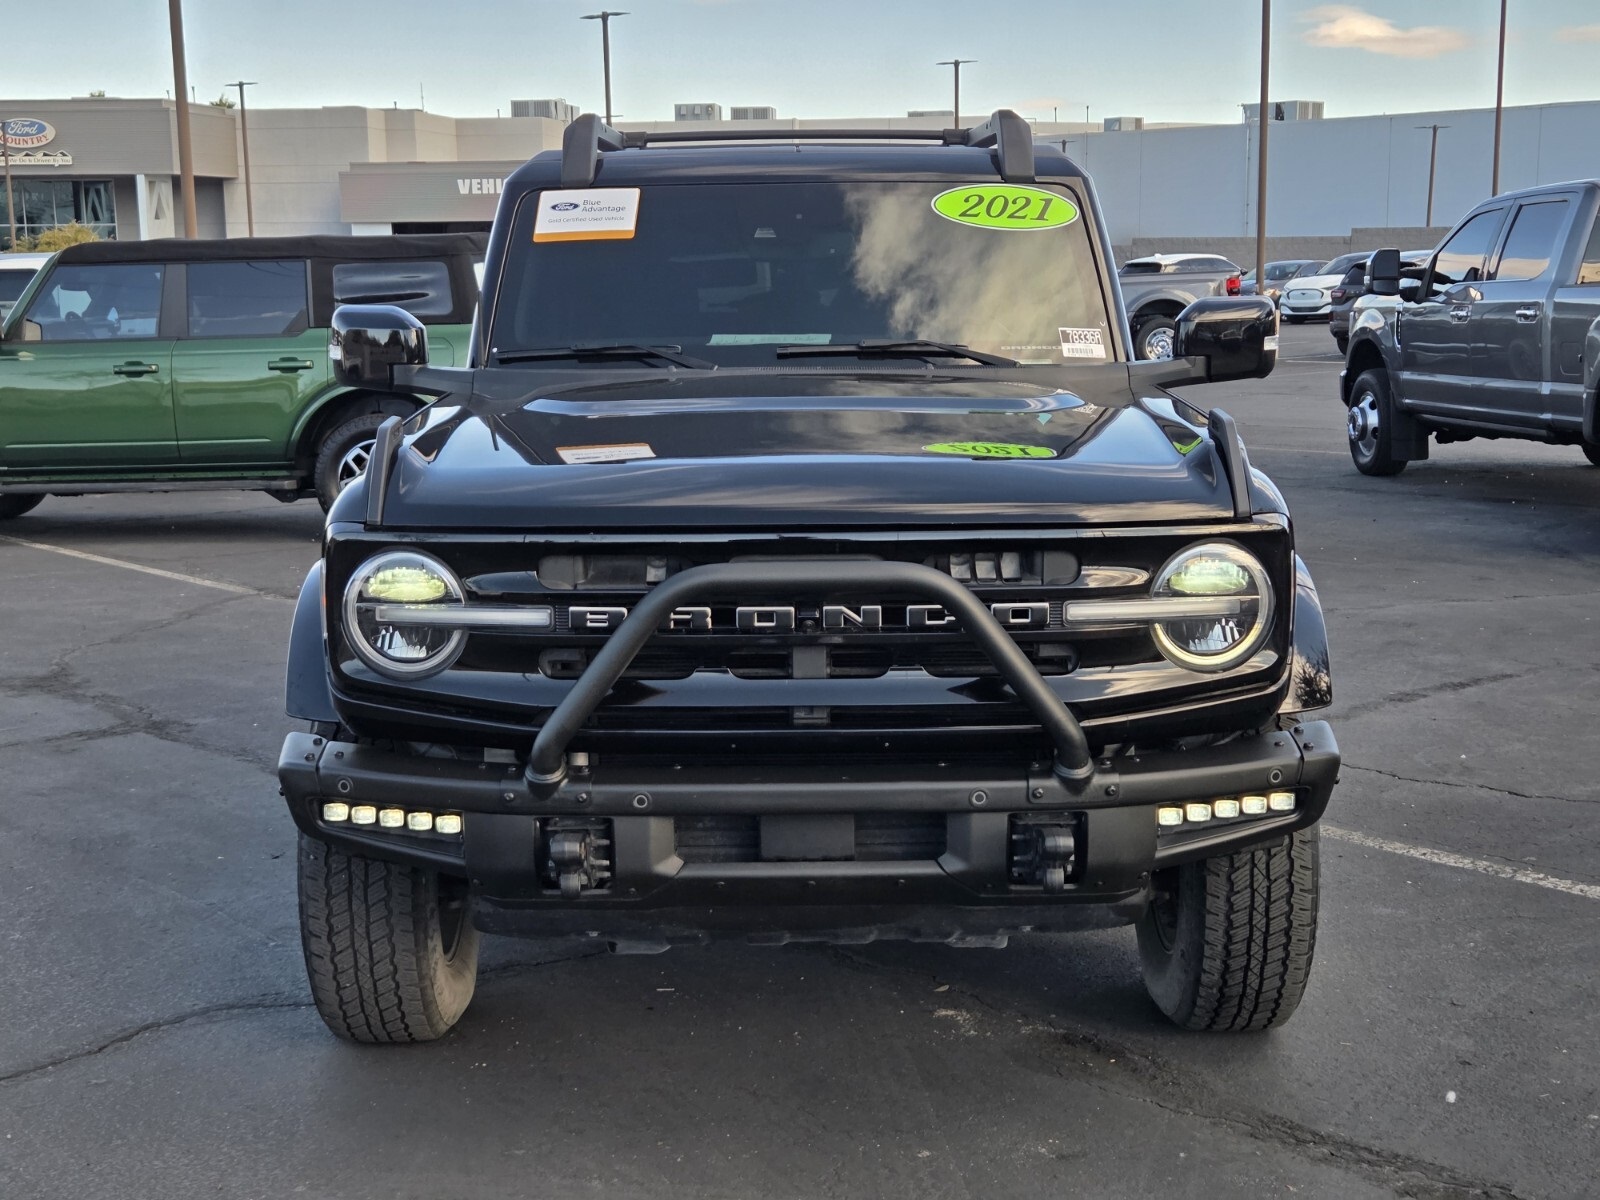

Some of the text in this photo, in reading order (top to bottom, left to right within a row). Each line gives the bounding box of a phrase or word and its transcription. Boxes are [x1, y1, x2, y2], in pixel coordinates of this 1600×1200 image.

[8, 121, 38, 134] Ford
[582, 205, 626, 213] Advantage
[958, 193, 1053, 221] 2021
[568, 602, 1050, 629] BRONCO
